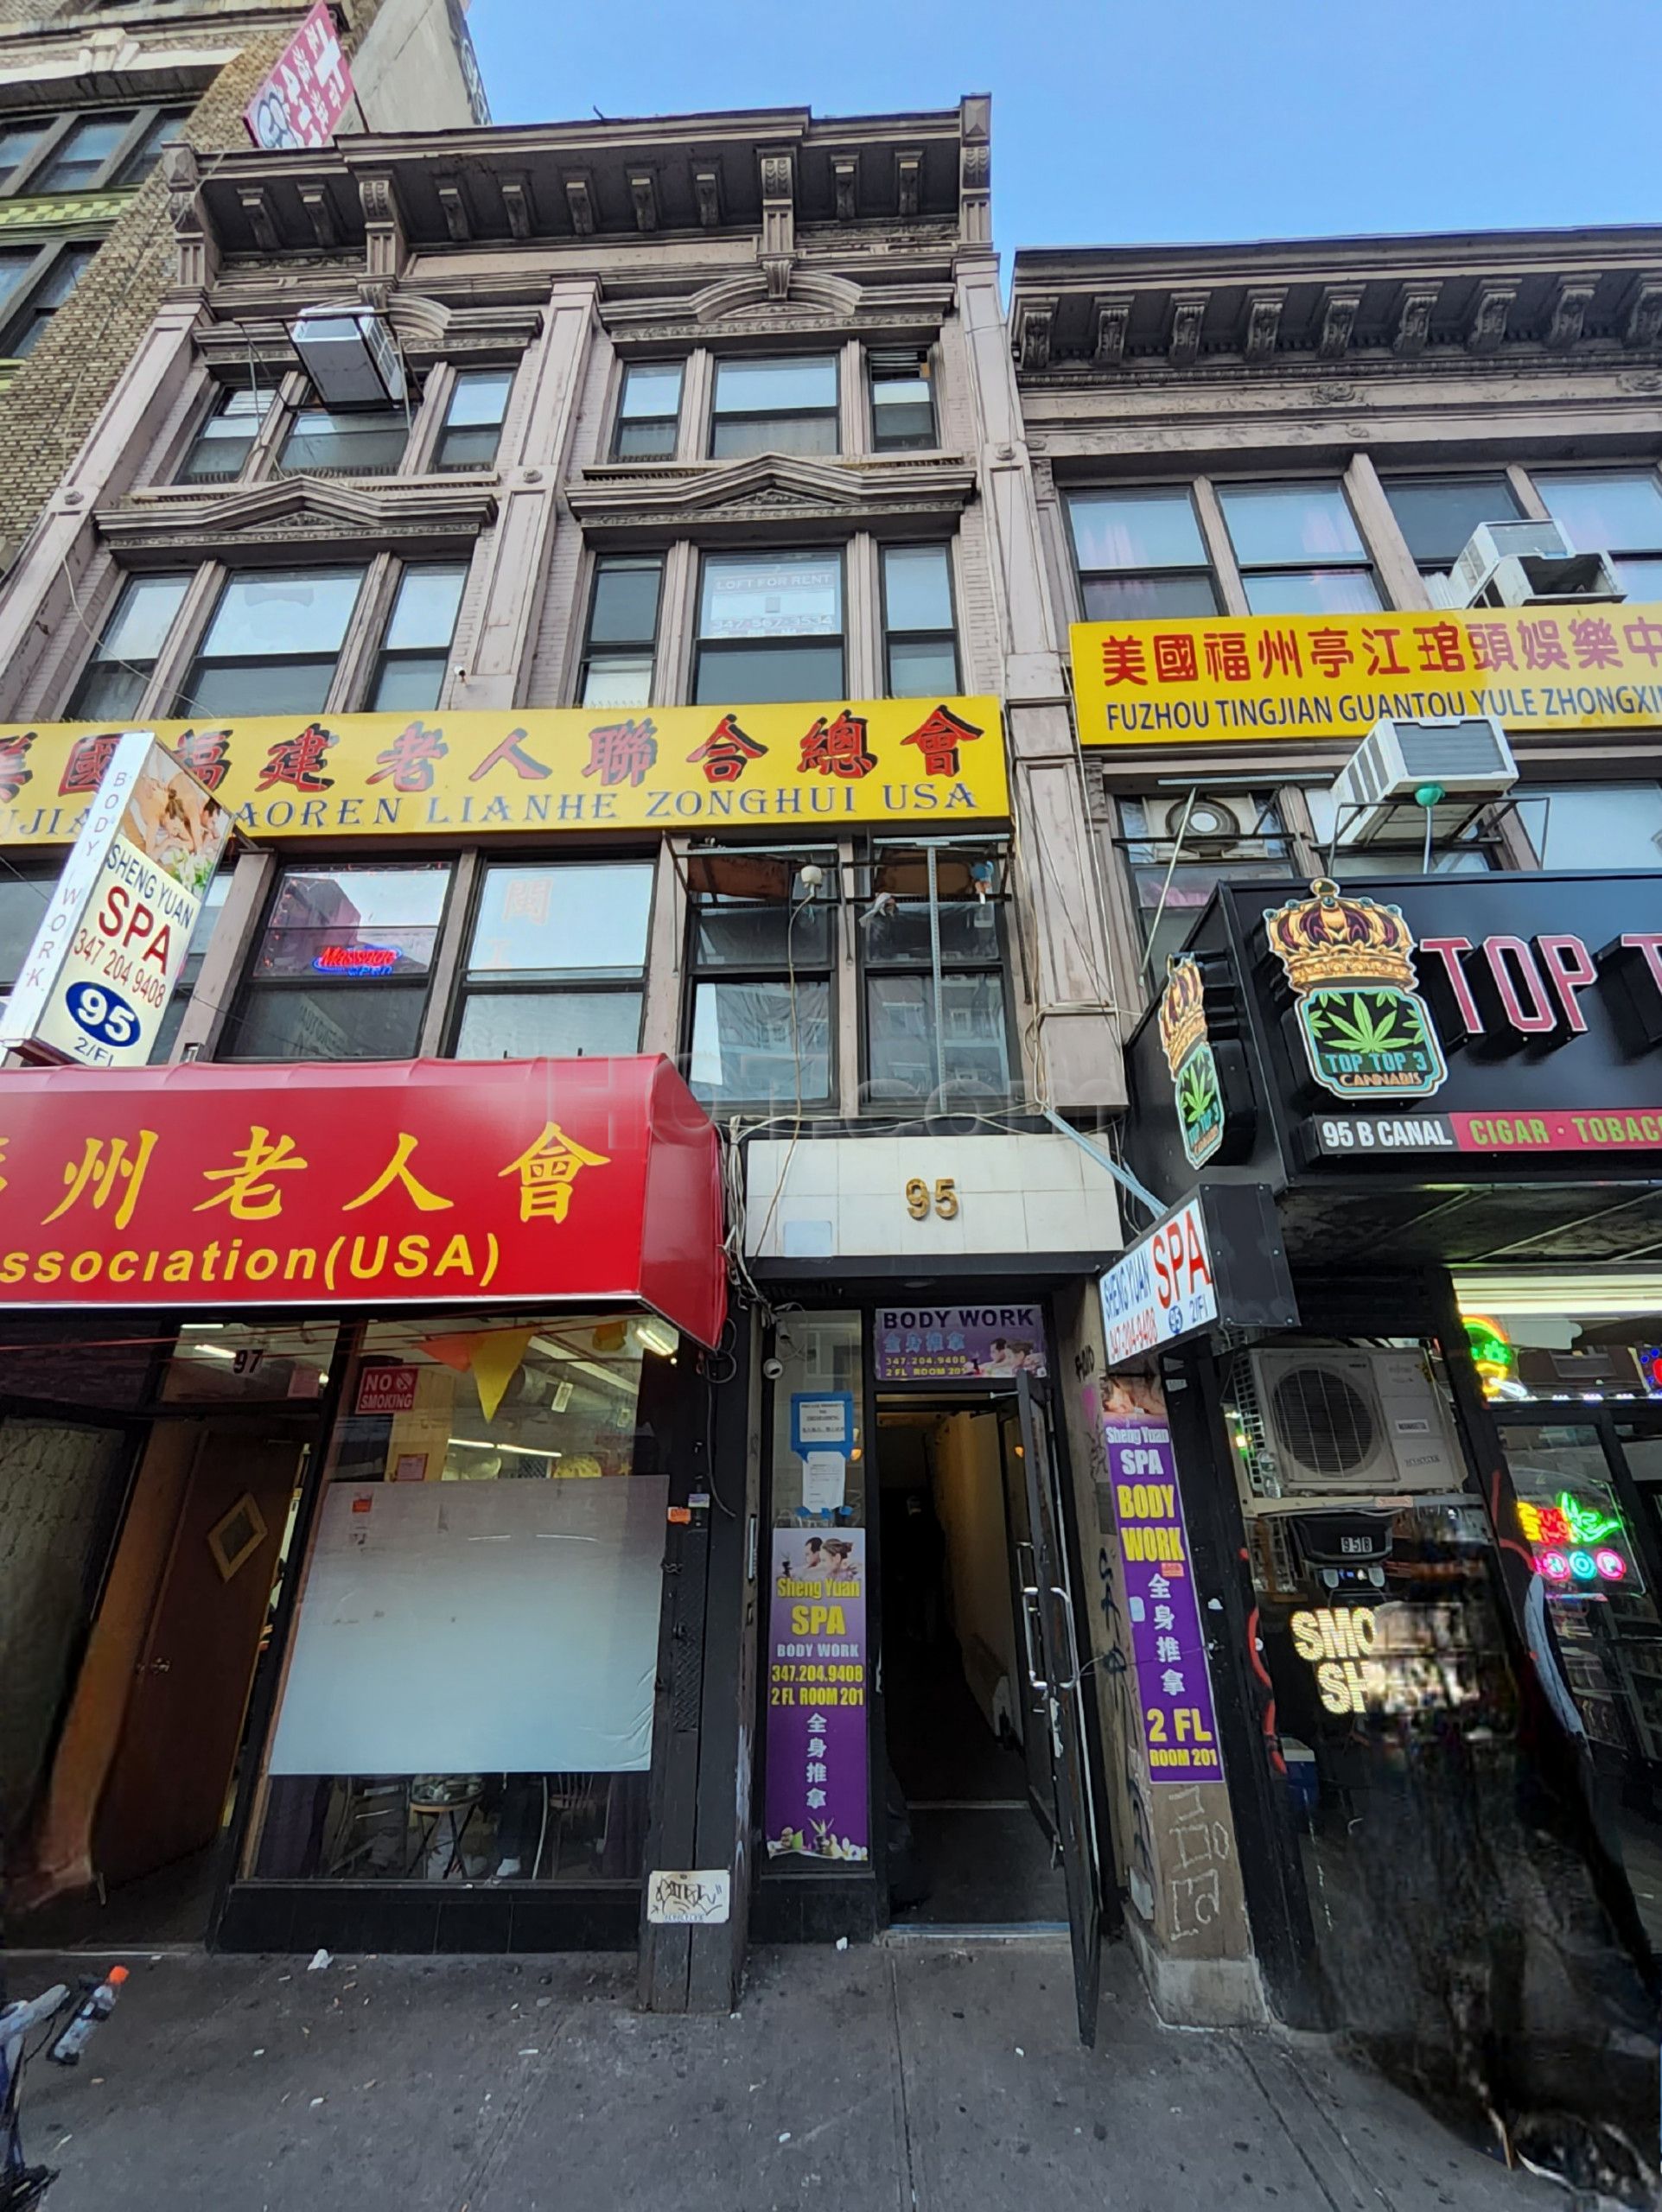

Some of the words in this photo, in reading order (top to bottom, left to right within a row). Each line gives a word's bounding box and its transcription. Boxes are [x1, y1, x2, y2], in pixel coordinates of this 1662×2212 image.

[716, 578, 753, 590] LOFT
[757, 575, 787, 588] FOR
[791, 574, 831, 586] RENT
[1105, 700, 1210, 731] FUZHOU
[1215, 696, 1334, 727] TINGJIAN
[1340, 692, 1465, 721] GUANTOU
[1471, 688, 1537, 717] YULE
[234, 797, 402, 829] AOREN
[426, 790, 618, 823] LIANHE
[646, 785, 856, 818] ZONGHUI
[883, 782, 978, 810] USA
[106, 844, 156, 899] SHENG
[157, 883, 194, 931] YUAN
[98, 885, 172, 976] SPA
[73, 928, 105, 966] 347
[103, 949, 133, 987] 204
[131, 968, 167, 1008] 9408
[1420, 934, 1597, 1033] TOP
[78, 988, 136, 1042] 95
[1325, 1053, 1364, 1072] TOP
[1369, 1052, 1408, 1071] TOP
[1414, 1051, 1429, 1070] 3
[1340, 1071, 1423, 1087] CANNABIS
[1321, 1122, 1354, 1147] 95
[1360, 1121, 1376, 1147] B
[1379, 1120, 1454, 1147] CANAL
[1469, 1118, 1551, 1146] CIGAR
[0, 1122, 611, 1230] 州老人會
[906, 1177, 959, 1221] 95
[0, 1232, 499, 1290] ssociation(USA)
[1152, 1209, 1213, 1310] SPA
[883, 1311, 951, 1330] BODY
[958, 1308, 1035, 1328] WORK
[233, 1348, 264, 1375] 97
[913, 1367, 946, 1376] ROOM
[365, 1374, 392, 1391] NO
[360, 1393, 413, 1409] SMOKING
[1105, 1426, 1142, 1446] Sheng
[1120, 1449, 1164, 1476] SPA
[1117, 1484, 1175, 1519] BODY
[1121, 1526, 1186, 1561] WORK
[777, 1578, 822, 1600] Sheng
[825, 1579, 861, 1599] Yuan
[792, 1605, 846, 1637] SPA
[1147, 1573, 1187, 1696] 全身推拿
[777, 1643, 812, 1658] BODY
[817, 1643, 860, 1658] WORK
[772, 1664, 863, 1683] 347.204.9408
[771, 1688, 780, 1706] 2
[781, 1688, 795, 1706] FL
[799, 1688, 838, 1706] ROOM
[840, 1688, 864, 1706] 201
[1147, 1708, 1168, 1742] 2
[1173, 1707, 1212, 1742] FL
[806, 1712, 828, 1809] 全身推拿
[1149, 1749, 1191, 1767] ROOM
[1191, 1748, 1218, 1767] 201
